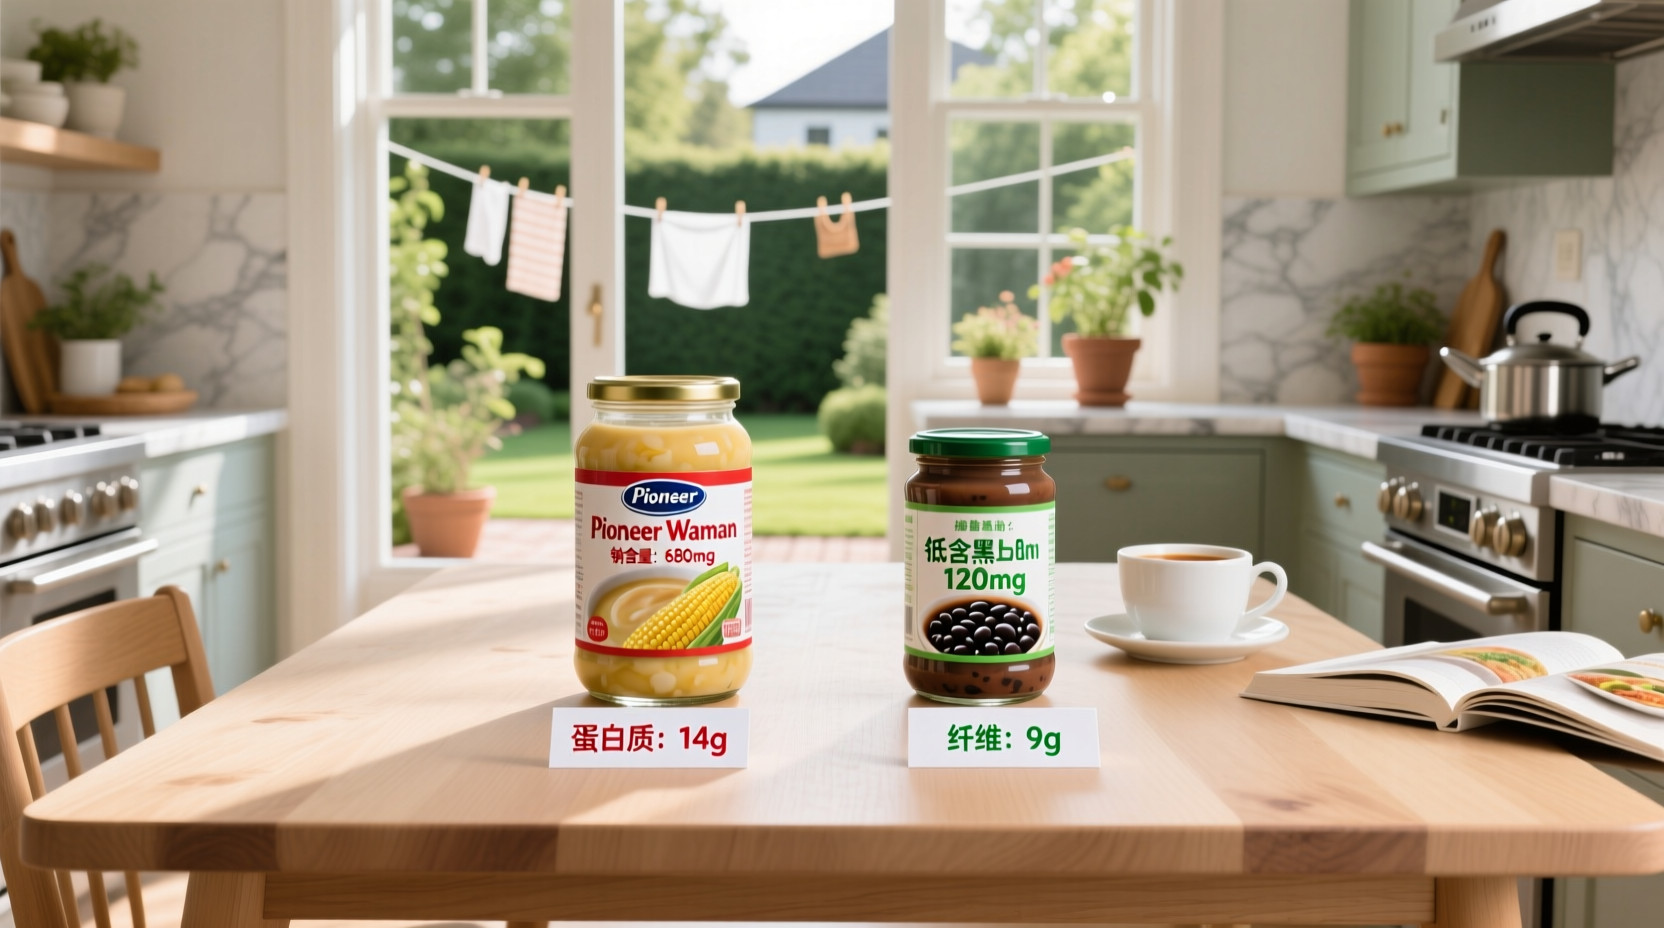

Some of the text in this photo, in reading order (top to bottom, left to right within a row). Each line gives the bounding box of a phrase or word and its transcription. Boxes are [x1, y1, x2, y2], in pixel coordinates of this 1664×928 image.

[631, 486, 698, 505] Pioneer
[591, 515, 737, 541] Pioneer Waman
[665, 548, 715, 566] 680mg
[944, 567, 1026, 595] 120mg
[679, 726, 727, 757] 14g
[1026, 725, 1061, 756] 9g
